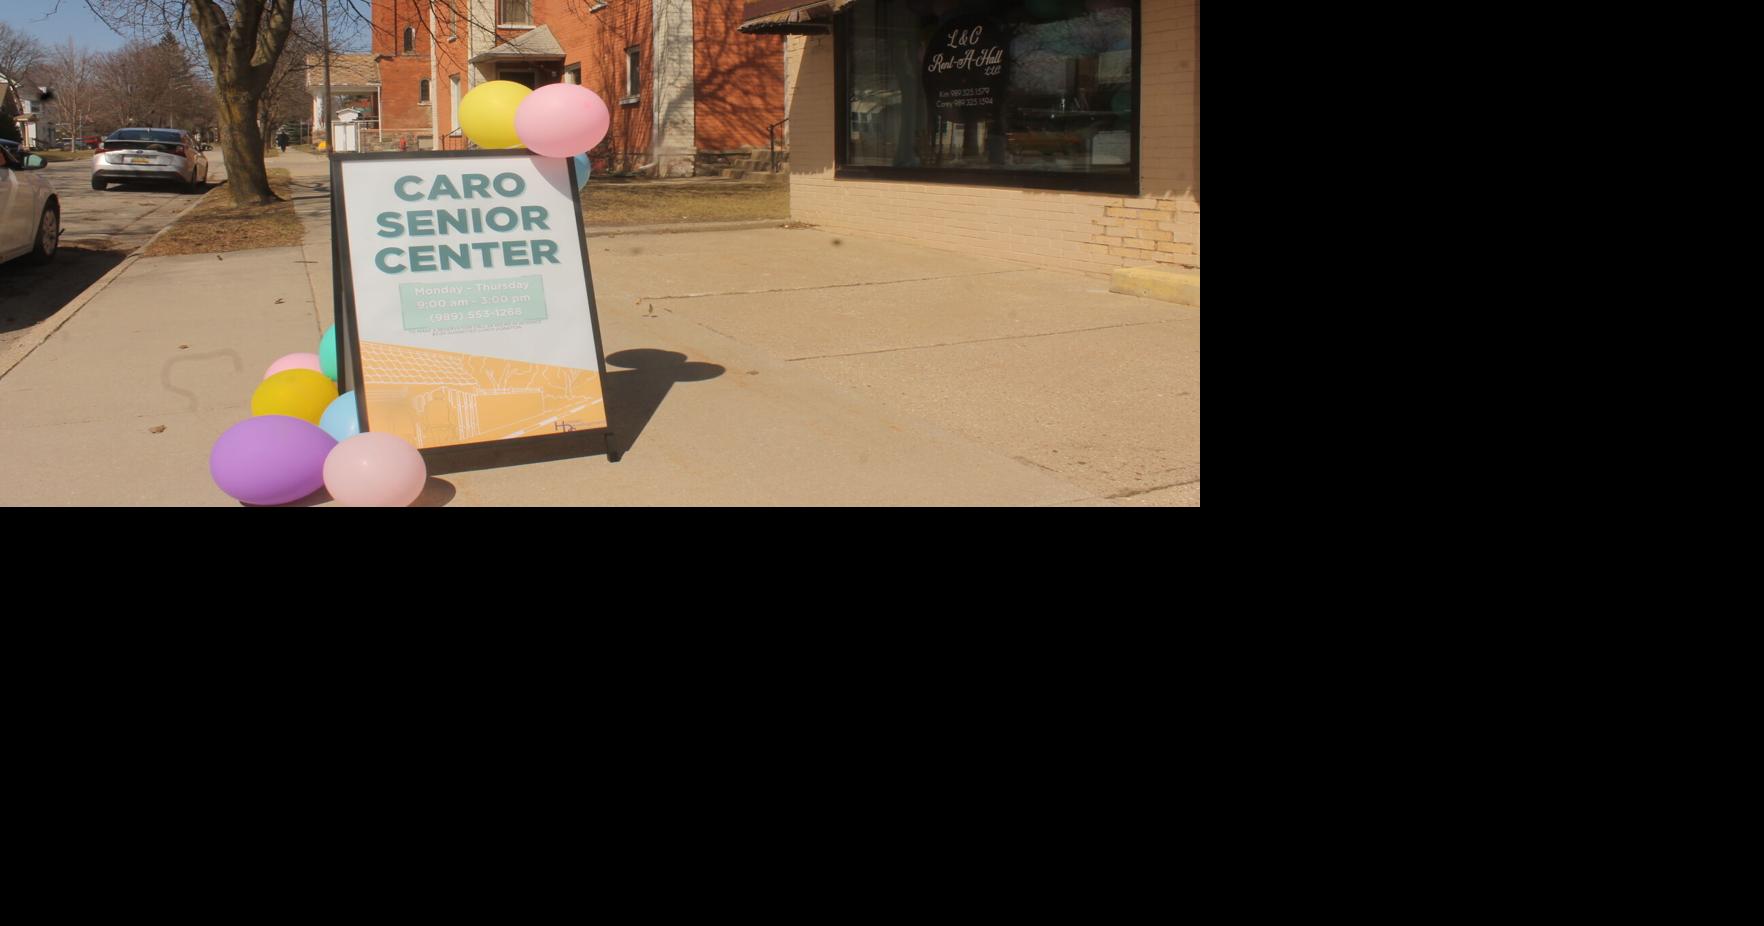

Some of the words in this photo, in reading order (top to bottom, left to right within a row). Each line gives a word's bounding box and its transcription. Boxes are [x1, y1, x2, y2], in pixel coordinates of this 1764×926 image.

[394, 171, 526, 202] CARO
[376, 205, 550, 239] SENIOR
[374, 239, 561, 275] CENTER
[414, 285, 463, 297] Monday
[476, 281, 529, 292] Thursday
[415, 299, 446, 310] 9:00
[450, 299, 468, 308] am
[480, 295, 508, 305] 3:00
[511, 295, 530, 305] pm
[430, 311, 463, 323] (989)
